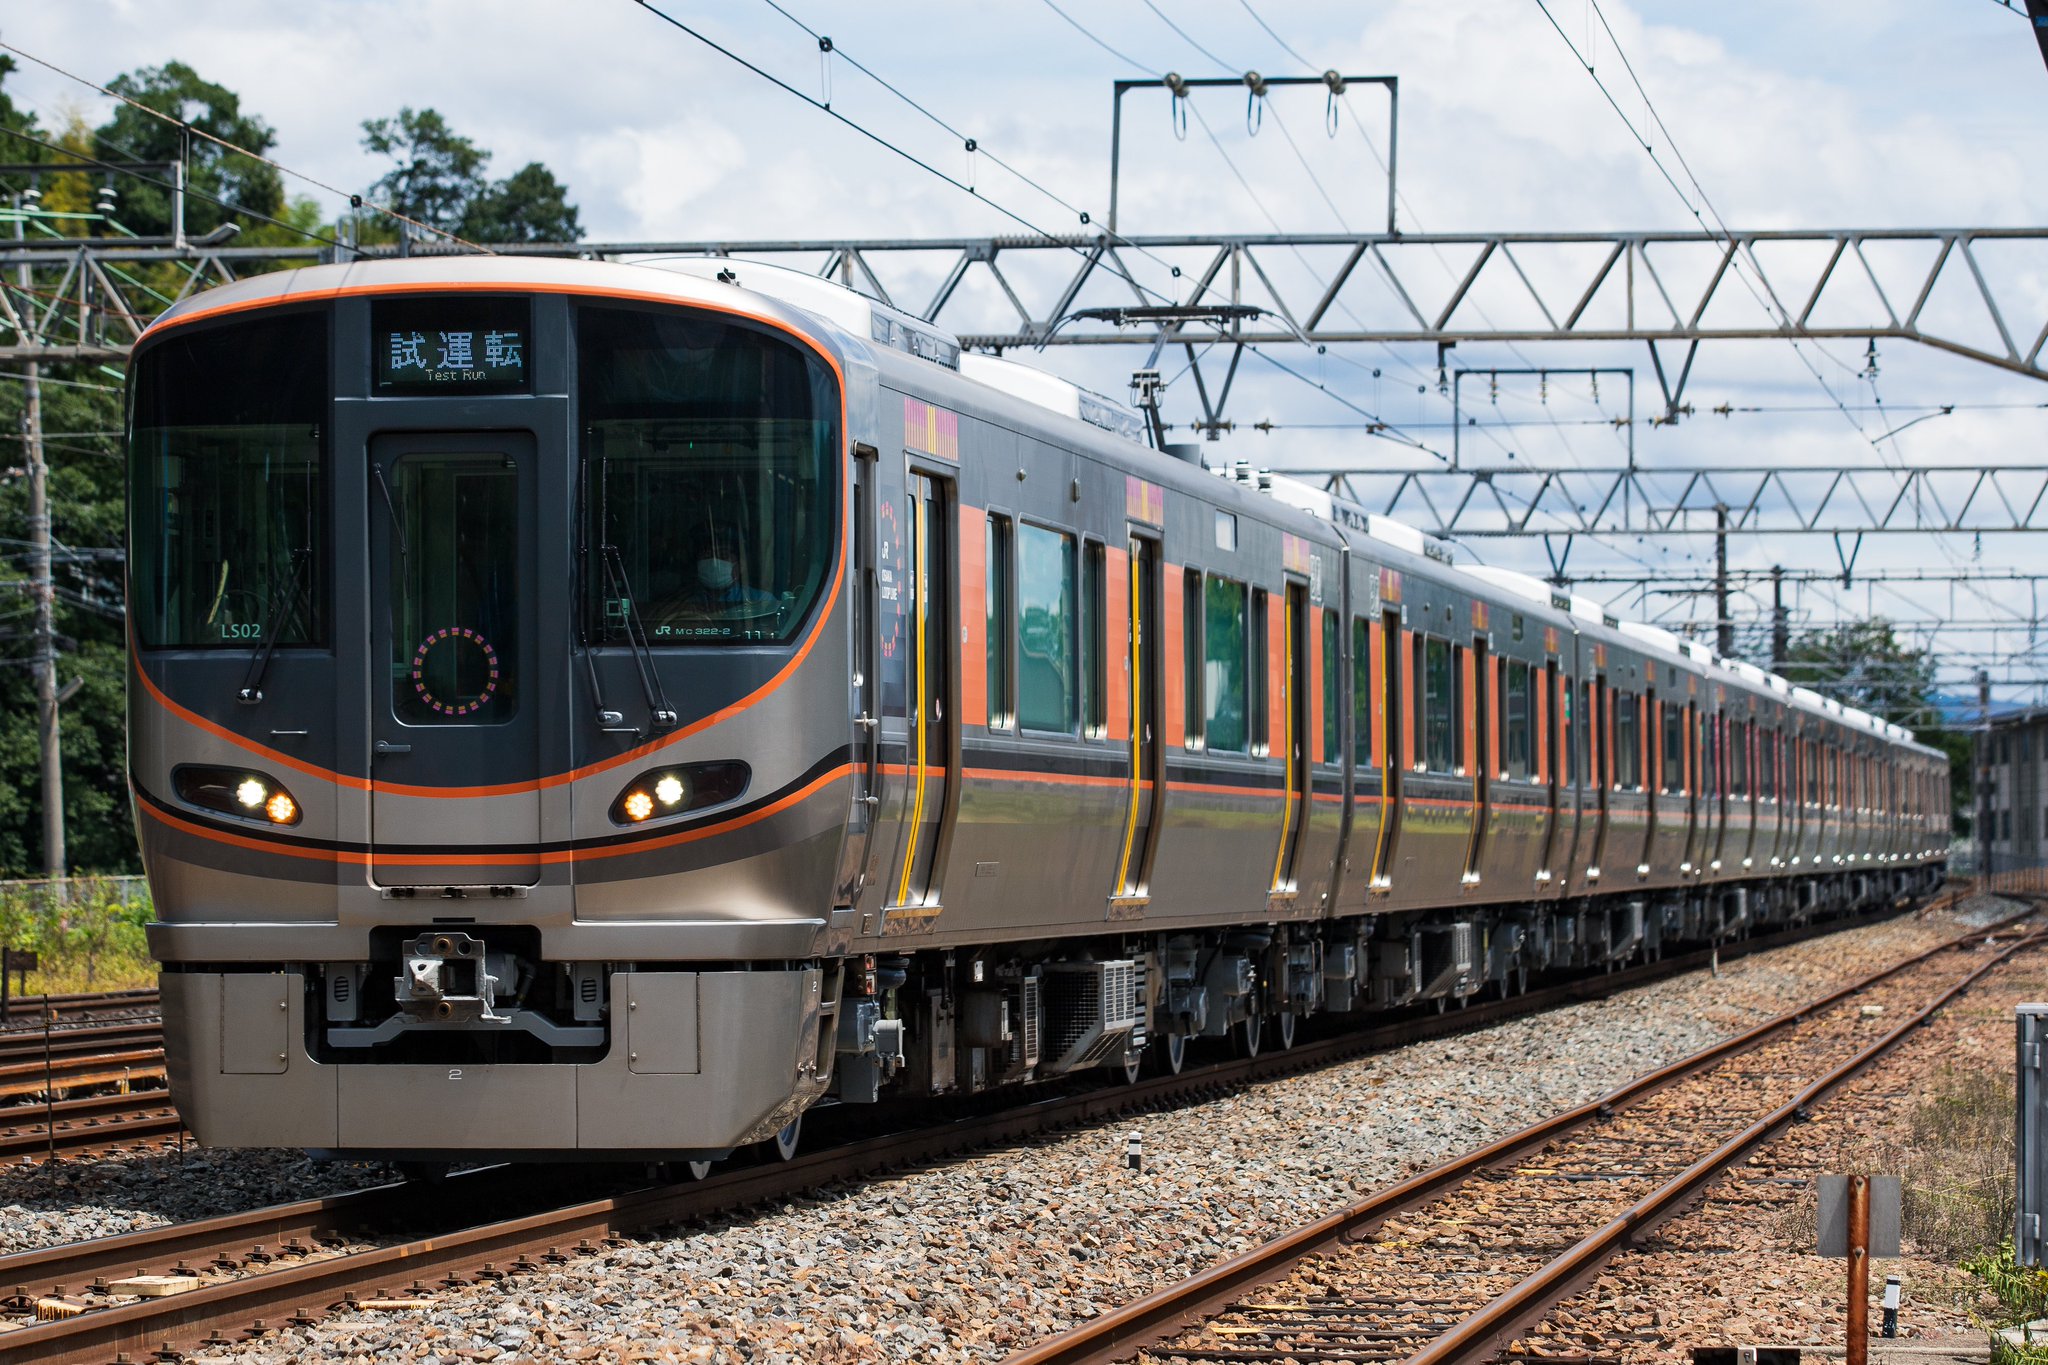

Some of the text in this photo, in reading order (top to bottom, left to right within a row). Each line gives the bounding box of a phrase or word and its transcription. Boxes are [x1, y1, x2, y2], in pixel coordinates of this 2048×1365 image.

[390, 330, 522, 369] 試運転
[425, 368, 487, 381] Test Run
[221, 623, 261, 638] LS02
[655, 625, 671, 635] JR
[812, 980, 818, 992] 2
[448, 1069, 462, 1080] 2
